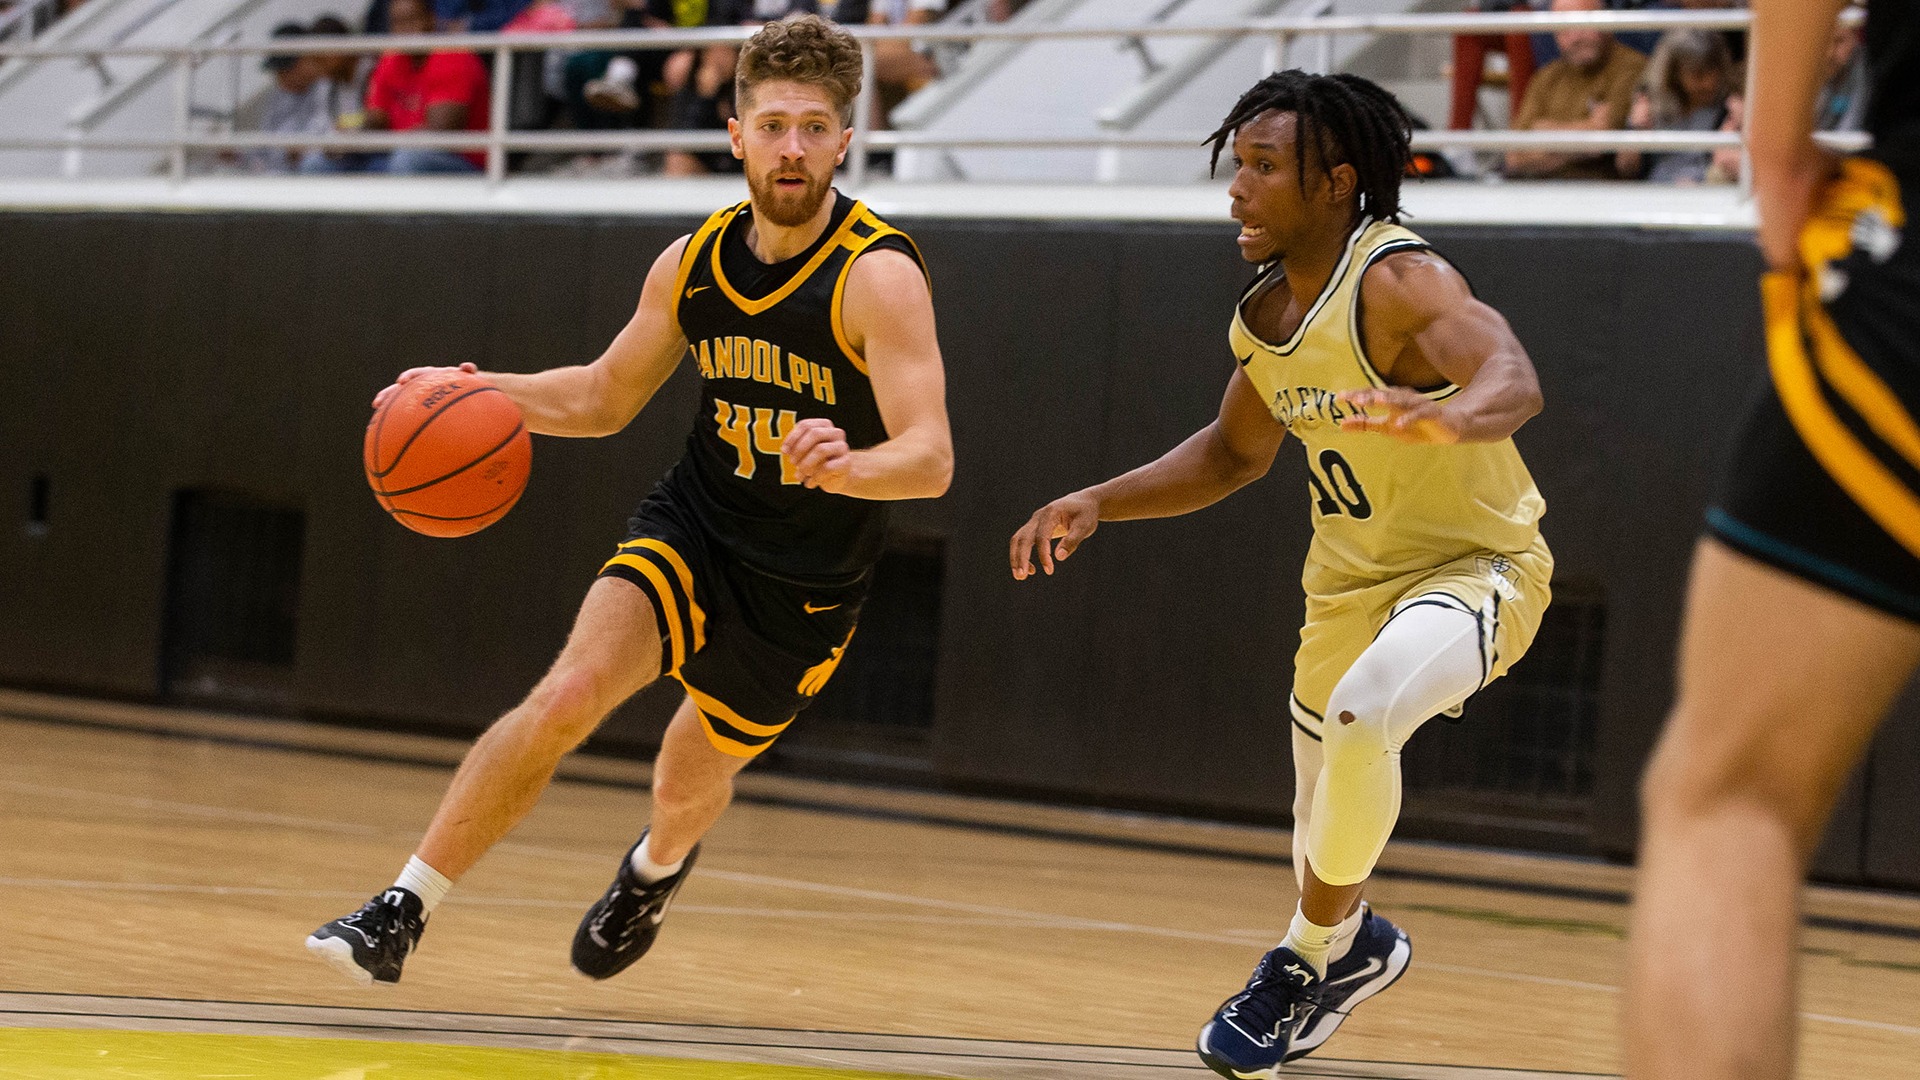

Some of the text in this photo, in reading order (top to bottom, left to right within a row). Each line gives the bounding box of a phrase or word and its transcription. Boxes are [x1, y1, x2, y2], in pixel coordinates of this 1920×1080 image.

[690, 336, 836, 405] ANDOLPH
[714, 398, 801, 485] 44
[1309, 449, 1372, 519] 10
